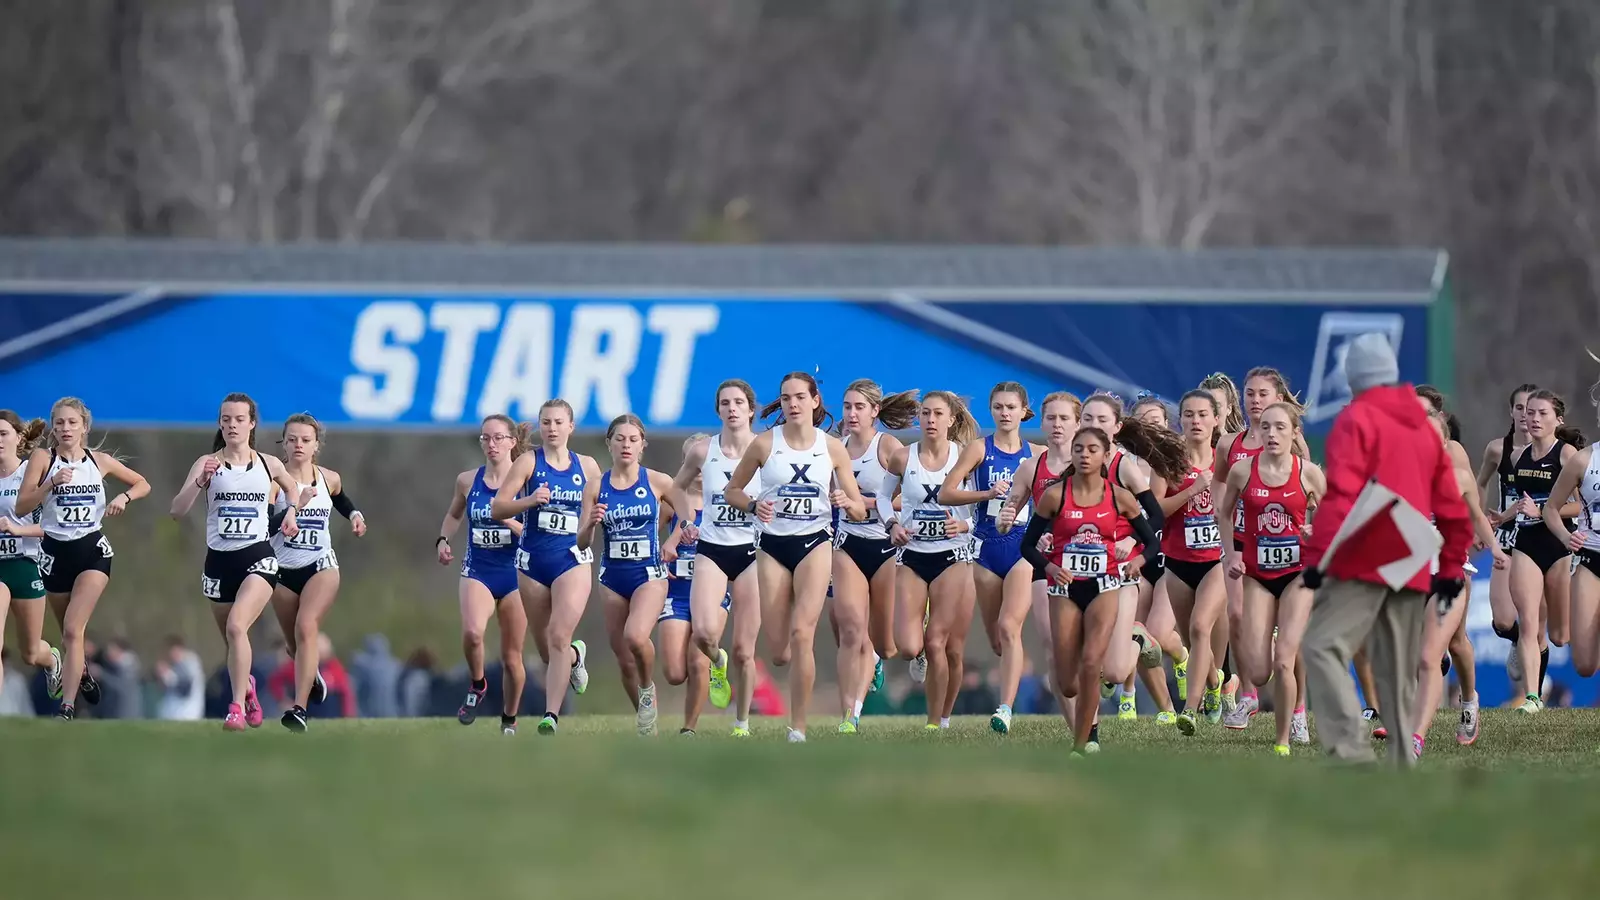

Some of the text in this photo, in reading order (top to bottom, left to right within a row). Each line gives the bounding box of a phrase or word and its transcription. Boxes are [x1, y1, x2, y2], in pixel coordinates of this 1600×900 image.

[341, 300, 719, 424] START
[789, 463, 812, 484] X
[988, 466, 1015, 483] Indi
[52, 484, 101, 496] MASTODONS
[214, 492, 266, 502] MASTODONS
[540, 484, 582, 502] diana
[295, 508, 329, 518] STODONS
[470, 502, 492, 520] Indi
[604, 503, 651, 522] ndiana
[717, 505, 746, 521] 284
[782, 498, 812, 514] 279
[62, 507, 91, 522] 212
[549, 514, 567, 530] 91
[223, 518, 252, 533] 217
[918, 521, 946, 536] 283
[482, 530, 500, 544] 88
[1192, 526, 1220, 544] 192
[620, 542, 639, 557] 94
[1263, 548, 1292, 563] 193
[1069, 554, 1100, 572] 196
[203, 578, 219, 595] 17
